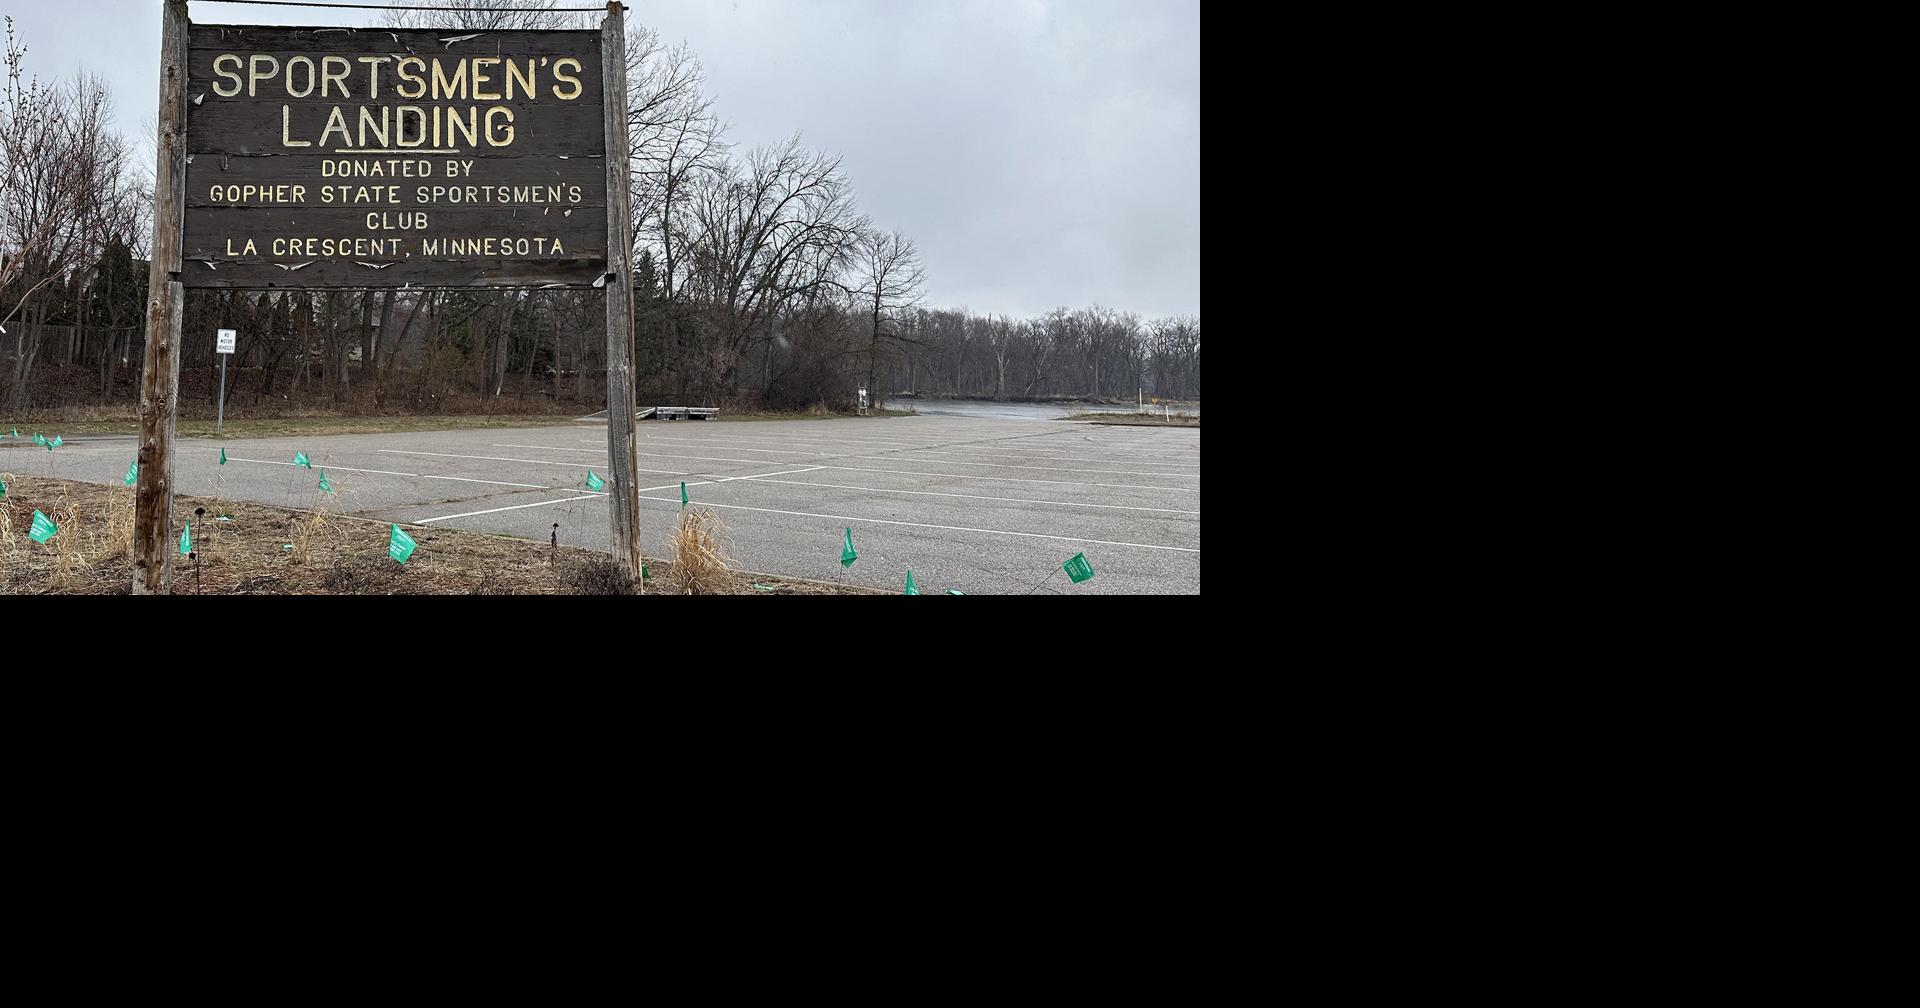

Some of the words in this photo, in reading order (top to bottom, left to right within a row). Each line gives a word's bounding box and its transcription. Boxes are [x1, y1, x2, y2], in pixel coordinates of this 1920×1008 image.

[213, 54, 582, 100] SPORTSMEN'S
[283, 105, 514, 147] LANDING
[322, 160, 431, 177] DONATED
[447, 160, 473, 177] BY
[210, 185, 305, 202] GOPHER
[321, 186, 400, 203] STATE
[417, 183, 581, 203] SPORTSMEN'S
[367, 212, 427, 229] CLUB
[227, 239, 257, 256] LA
[273, 238, 410, 257] CRESCENT,
[423, 238, 563, 255] MINNESOTA
